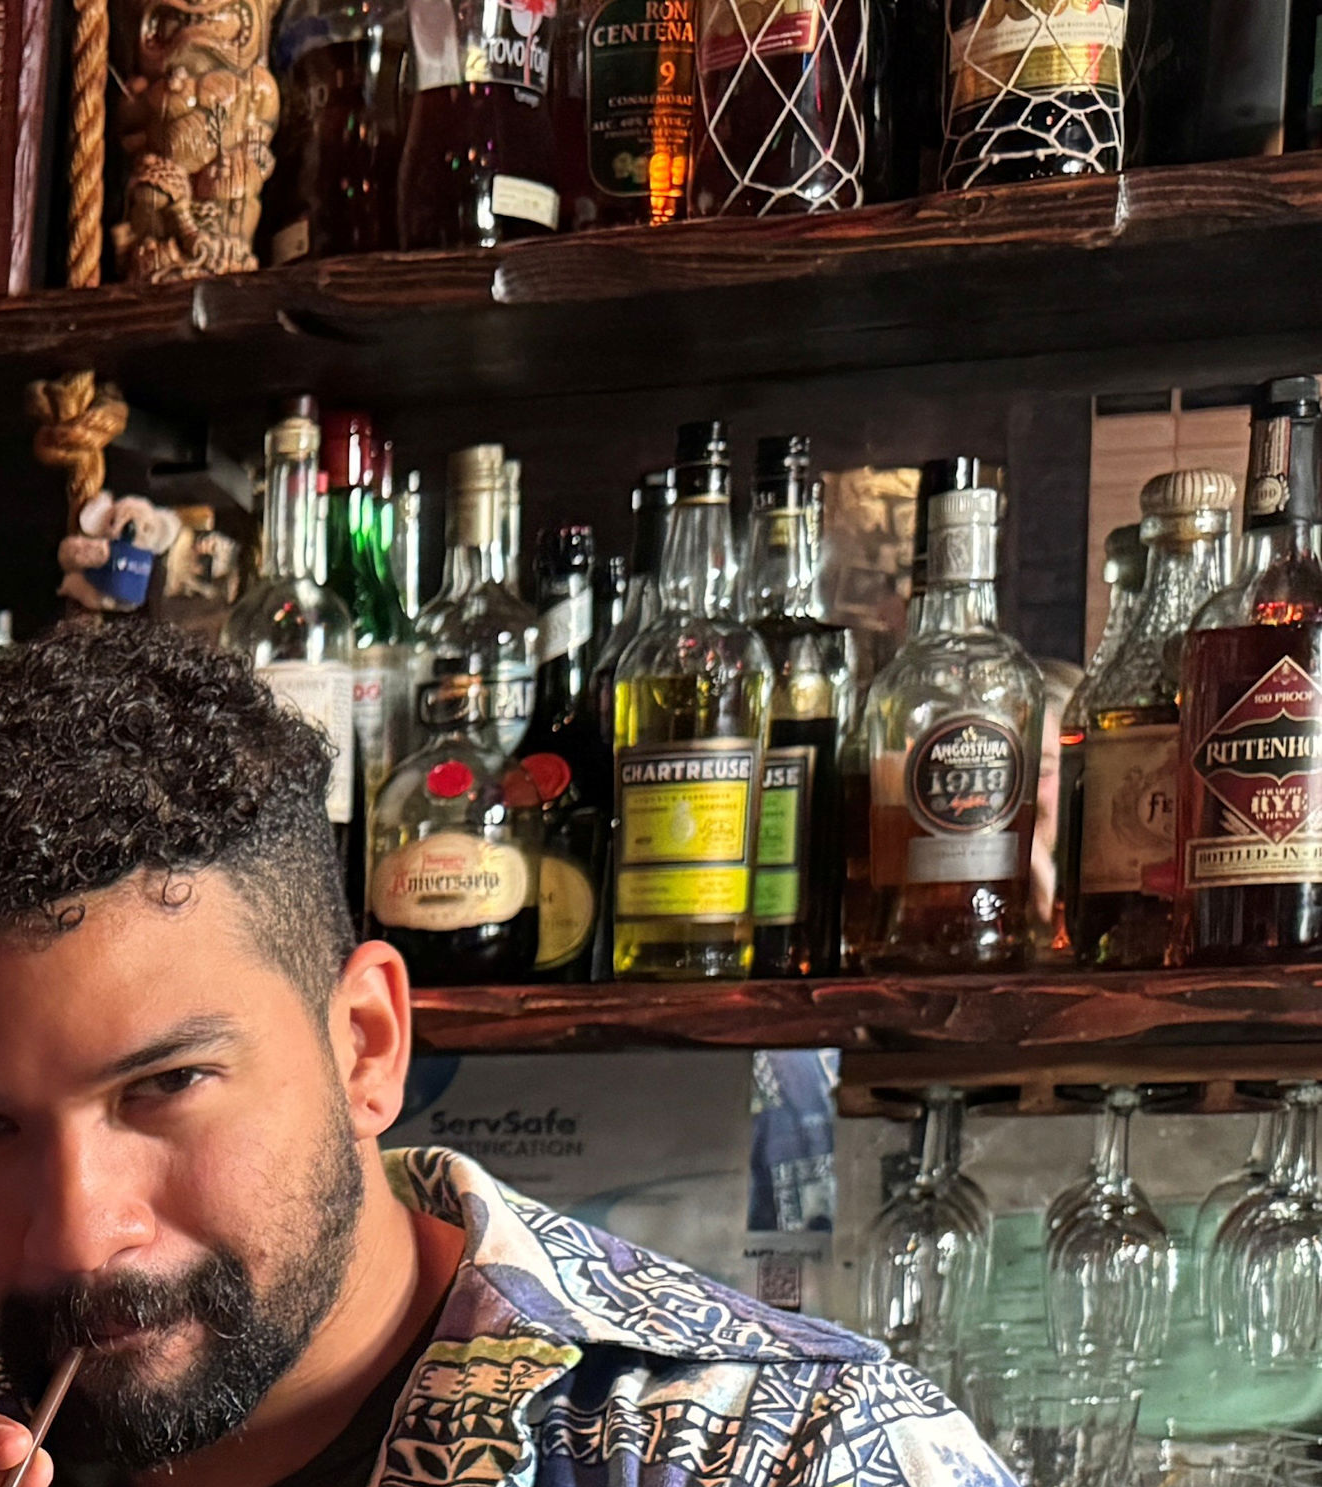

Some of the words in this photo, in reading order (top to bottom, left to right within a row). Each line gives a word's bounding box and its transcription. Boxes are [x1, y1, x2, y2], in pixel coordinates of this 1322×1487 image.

[646, 0, 688, 20] RON
[592, 22, 694, 47] CENTENA
[659, 61, 676, 86] 9
[1255, 691, 1272, 703] 100
[1275, 689, 1315, 703] PROOF
[930, 740, 1008, 762] ANGOSTURA
[622, 757, 751, 784] CHARTREUSE
[928, 767, 1007, 796] 1919
[1251, 795, 1309, 814] RYE
[1198, 847, 1269, 865] BOTTLED
[391, 870, 501, 899] Aniversario
[430, 1107, 577, 1135] ServSafe
